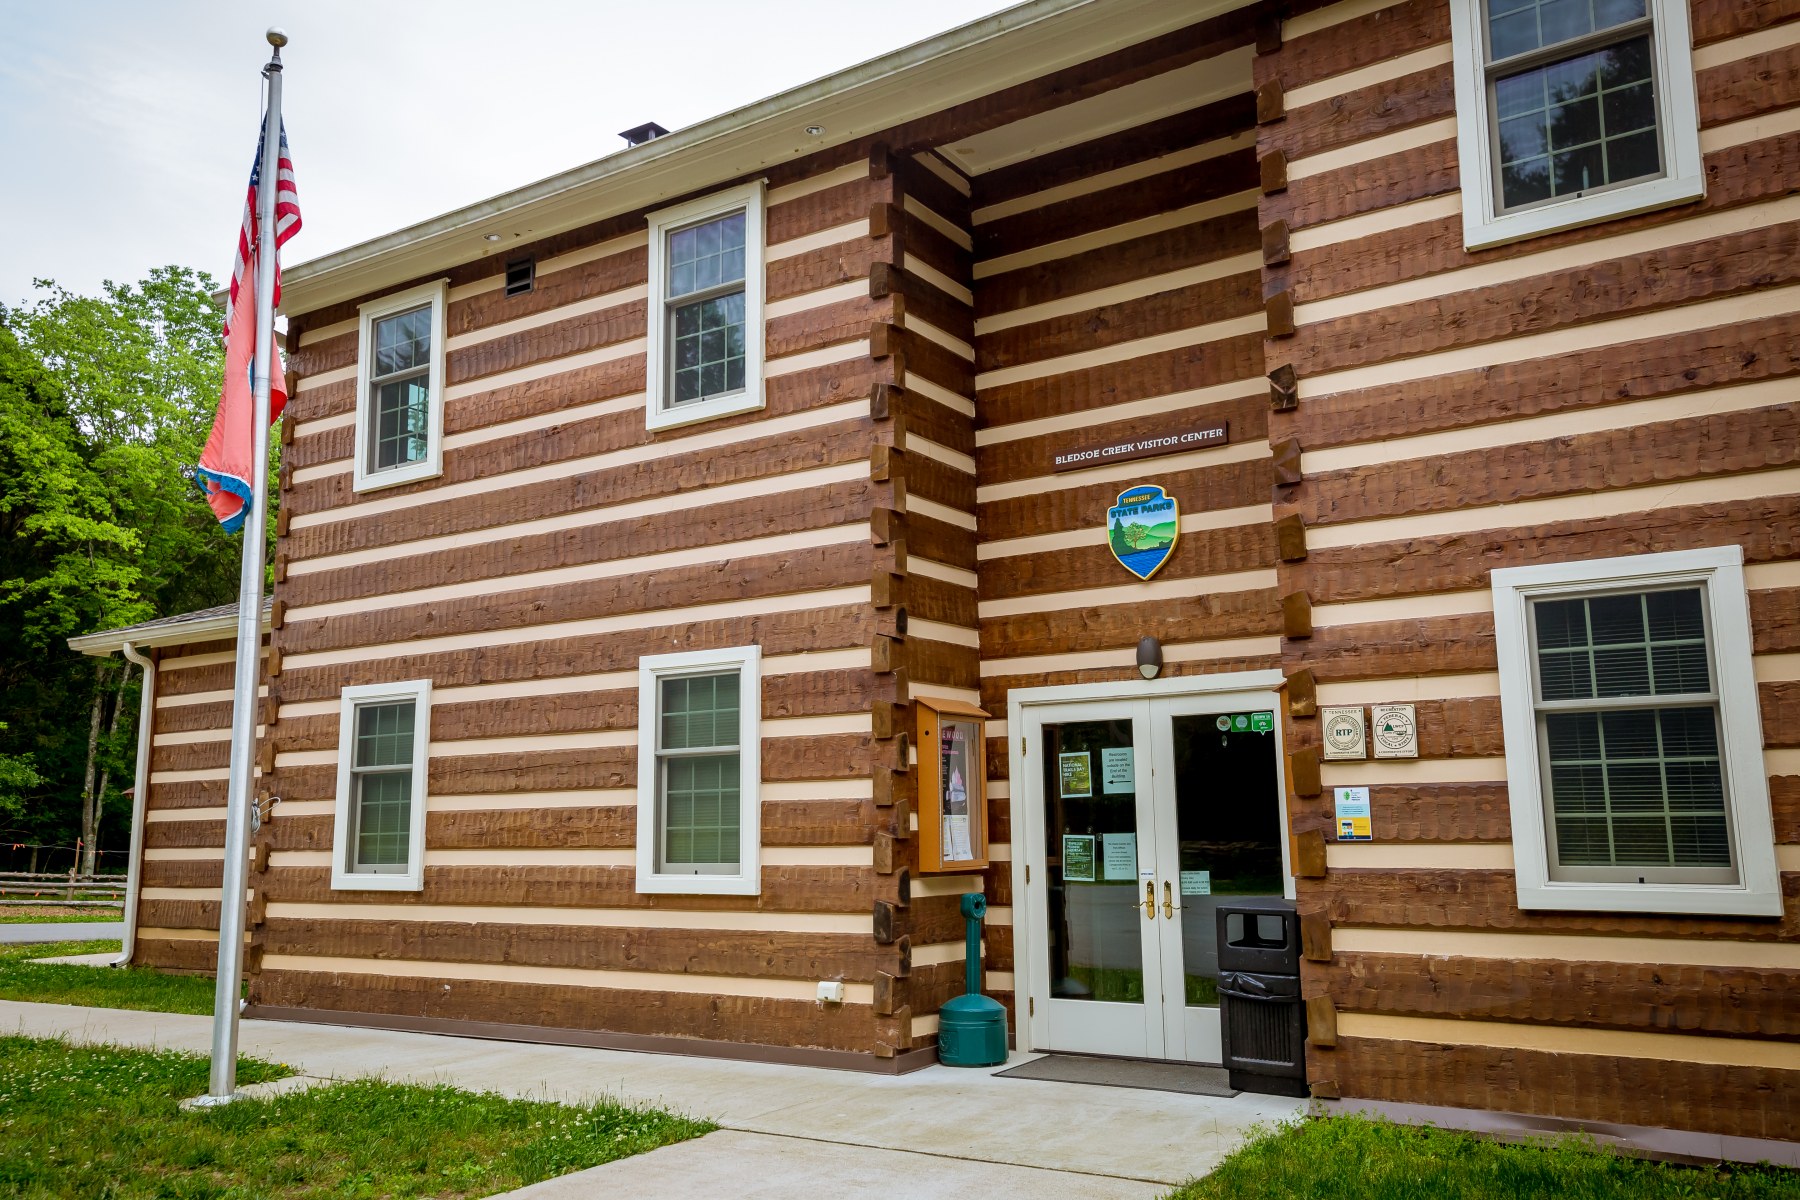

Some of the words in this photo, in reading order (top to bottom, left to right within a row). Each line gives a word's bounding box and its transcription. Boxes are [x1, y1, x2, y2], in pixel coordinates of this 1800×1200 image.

[1055, 449, 1100, 465] BLEDSOE
[1102, 443, 1135, 456] CREEK
[1136, 435, 1178, 450] VISITOR
[1180, 428, 1223, 443] CENTER
[1123, 493, 1151, 504] TENNESSEE
[1110, 506, 1139, 518] STATE
[1141, 502, 1172, 514] PARKS
[1335, 728, 1353, 737] RTP
